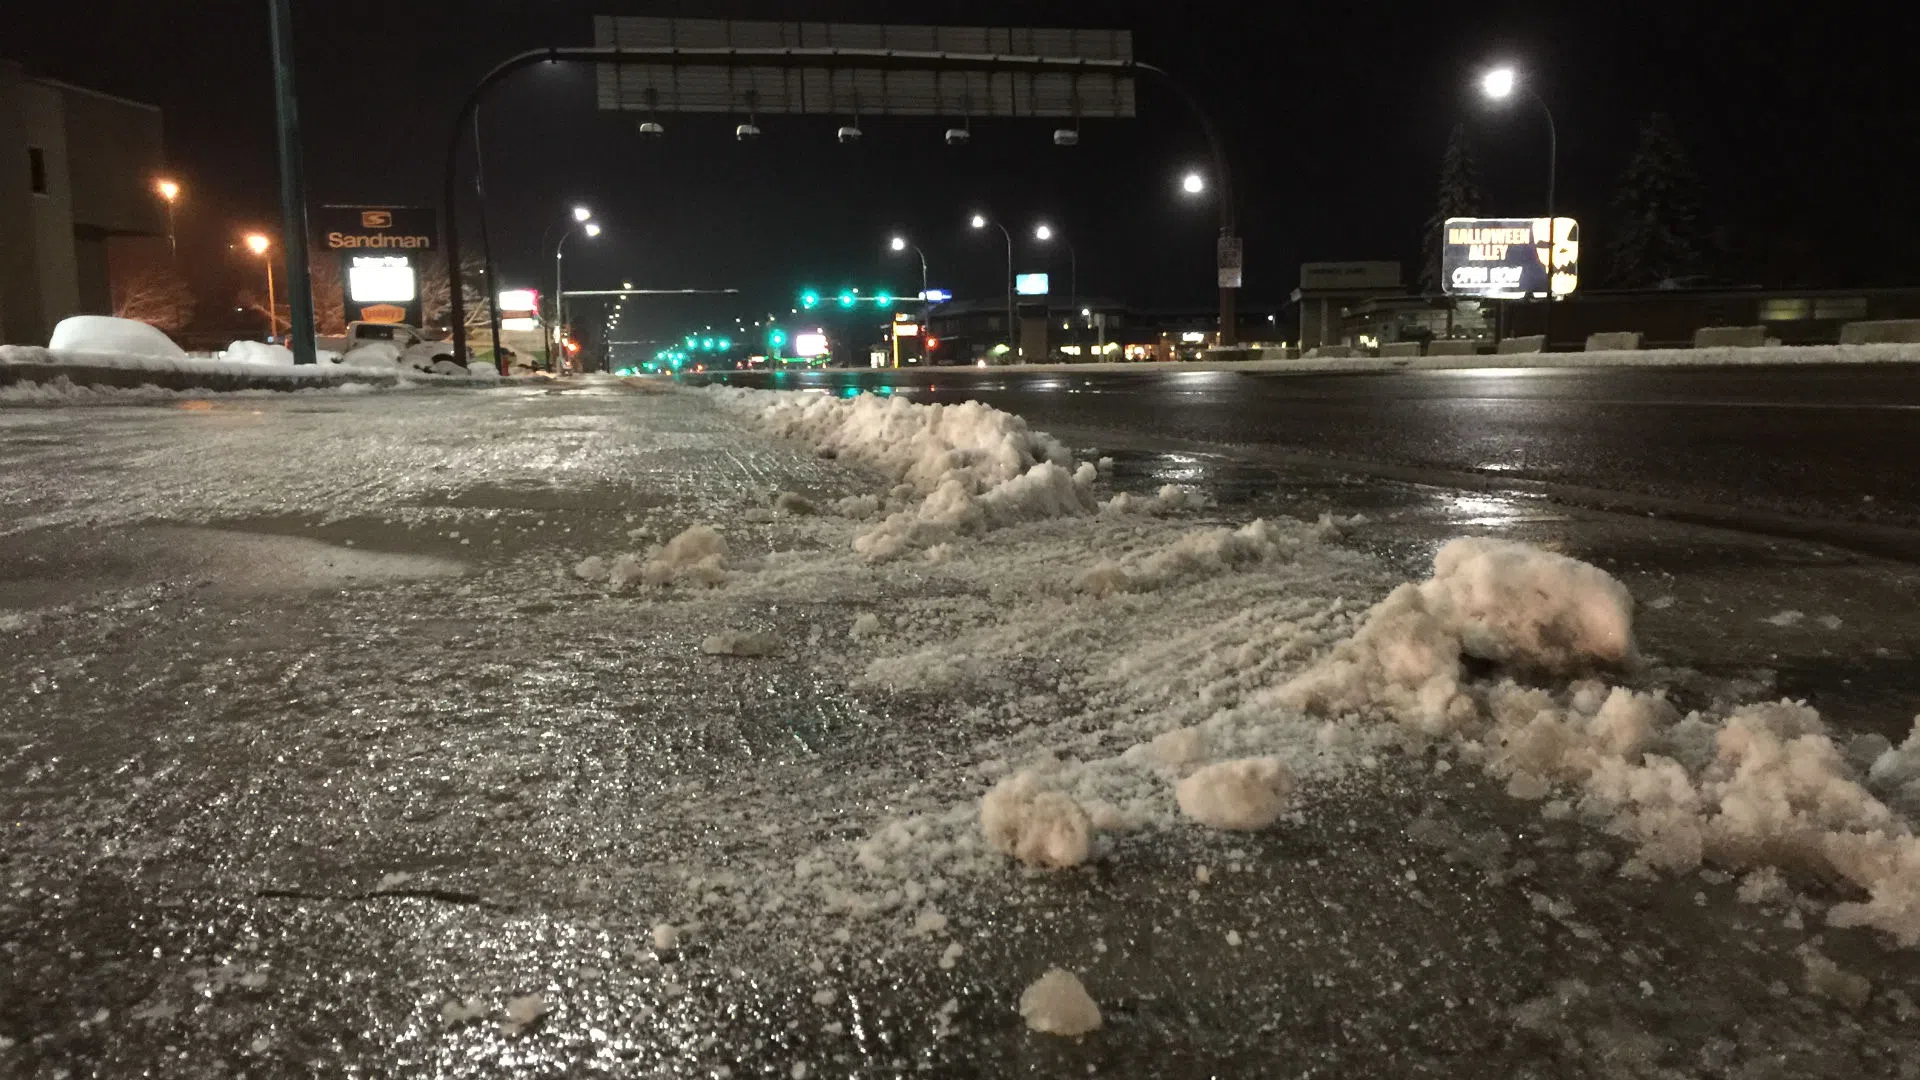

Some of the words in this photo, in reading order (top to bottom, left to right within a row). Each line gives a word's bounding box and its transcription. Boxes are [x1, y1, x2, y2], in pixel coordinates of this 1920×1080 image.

[328, 232, 429, 248] Sandman
[1449, 229, 1530, 244] HALLOWEEN
[1469, 245, 1508, 260] ALLEY
